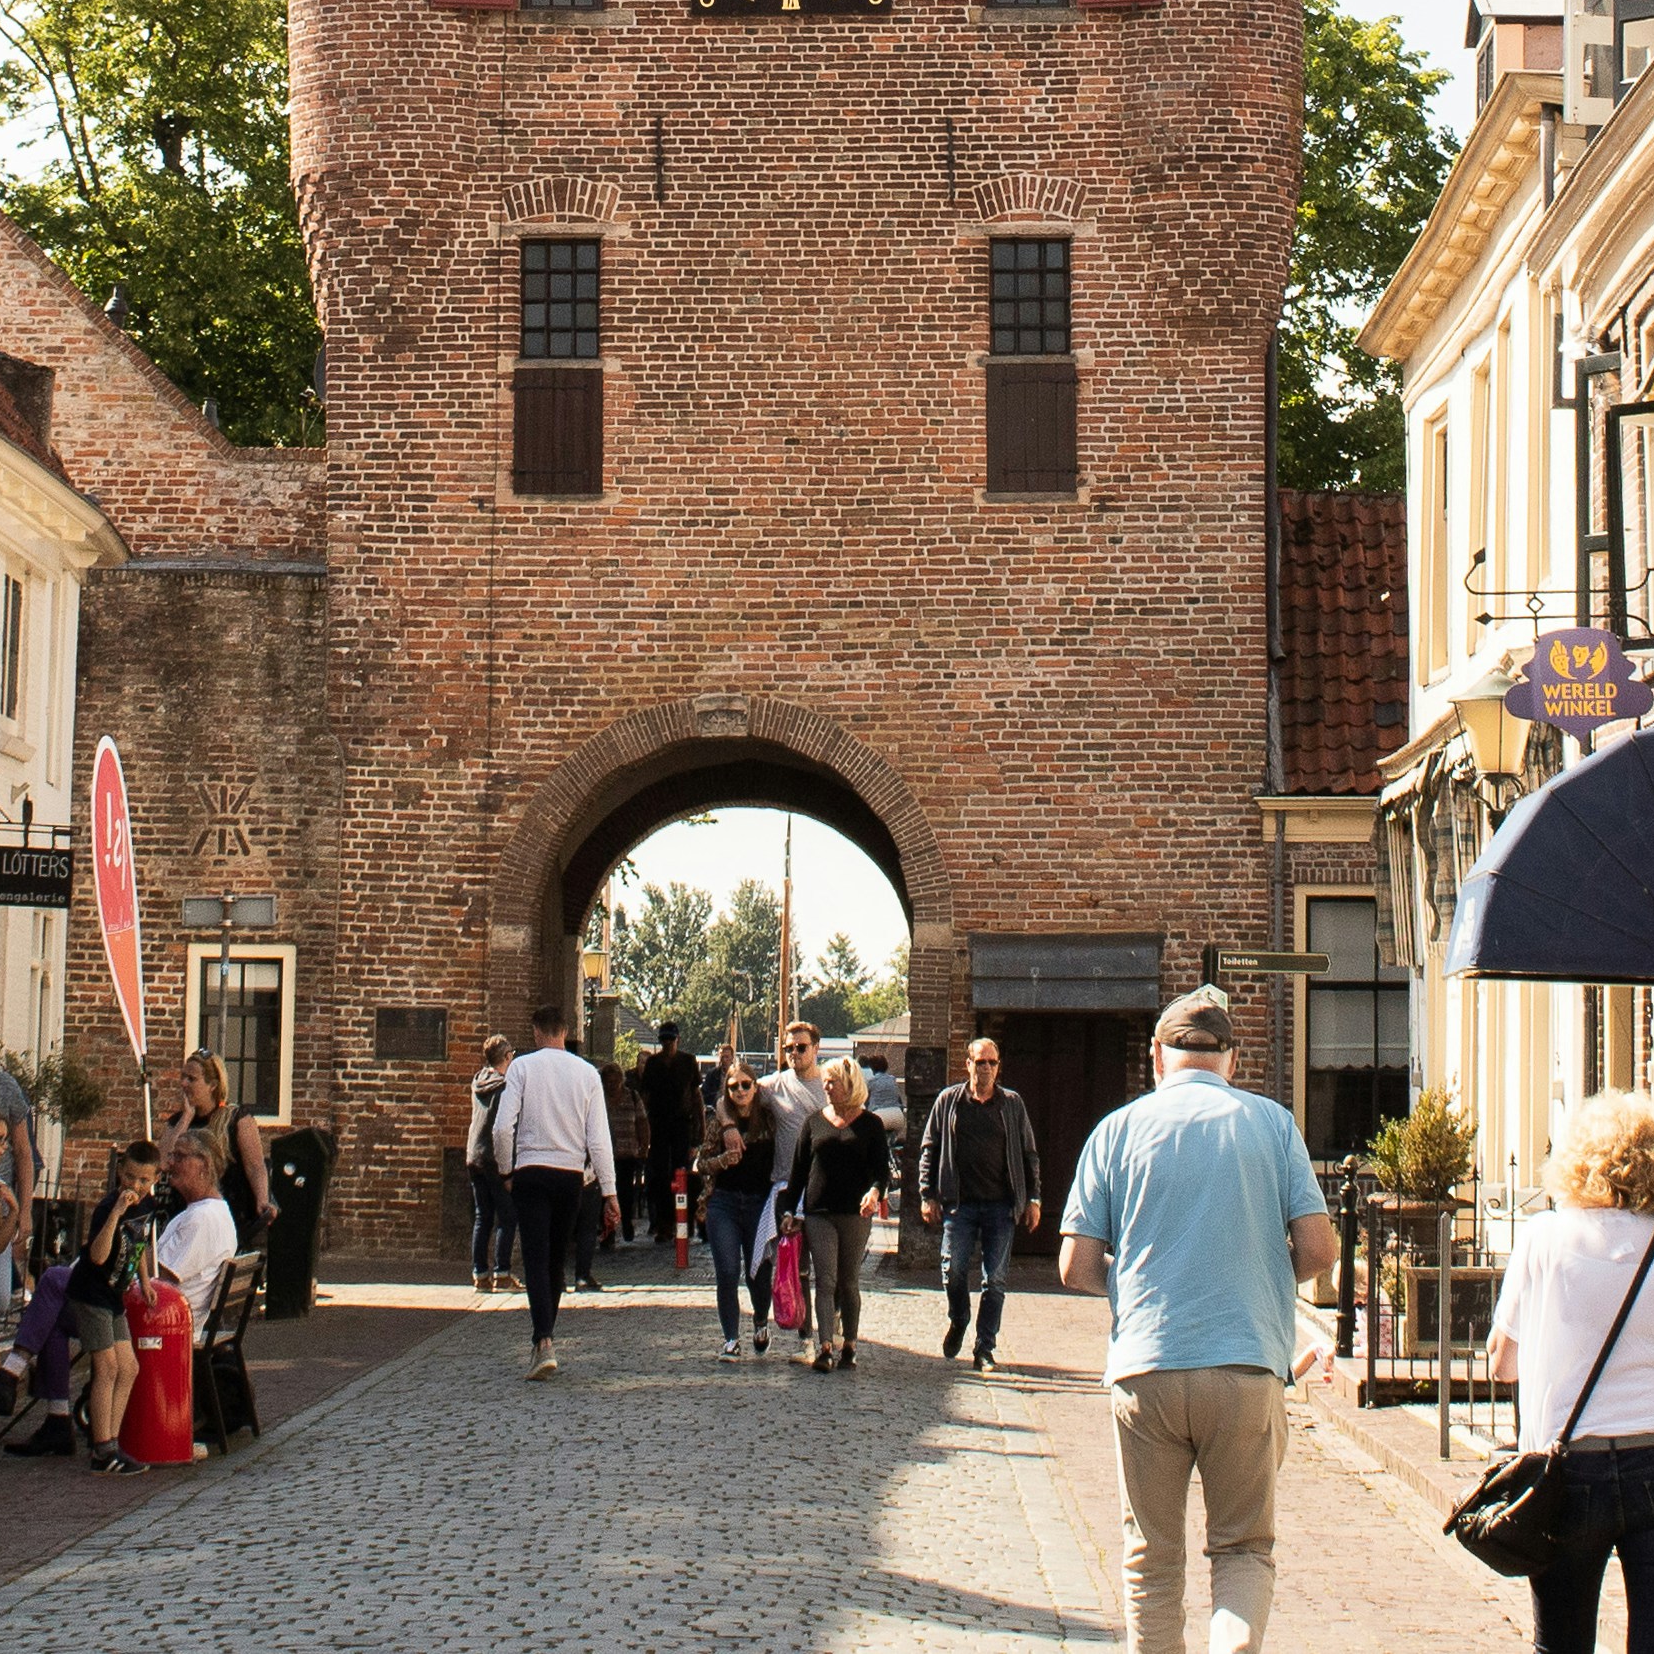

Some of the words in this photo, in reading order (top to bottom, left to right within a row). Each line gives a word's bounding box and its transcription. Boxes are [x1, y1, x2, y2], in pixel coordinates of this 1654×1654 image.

[1541, 683, 1618, 700] WERELD
[1544, 700, 1617, 717] WINKEL
[2, 850, 70, 879] LÖTTERS
[1222, 957, 1259, 966] Toiletten
